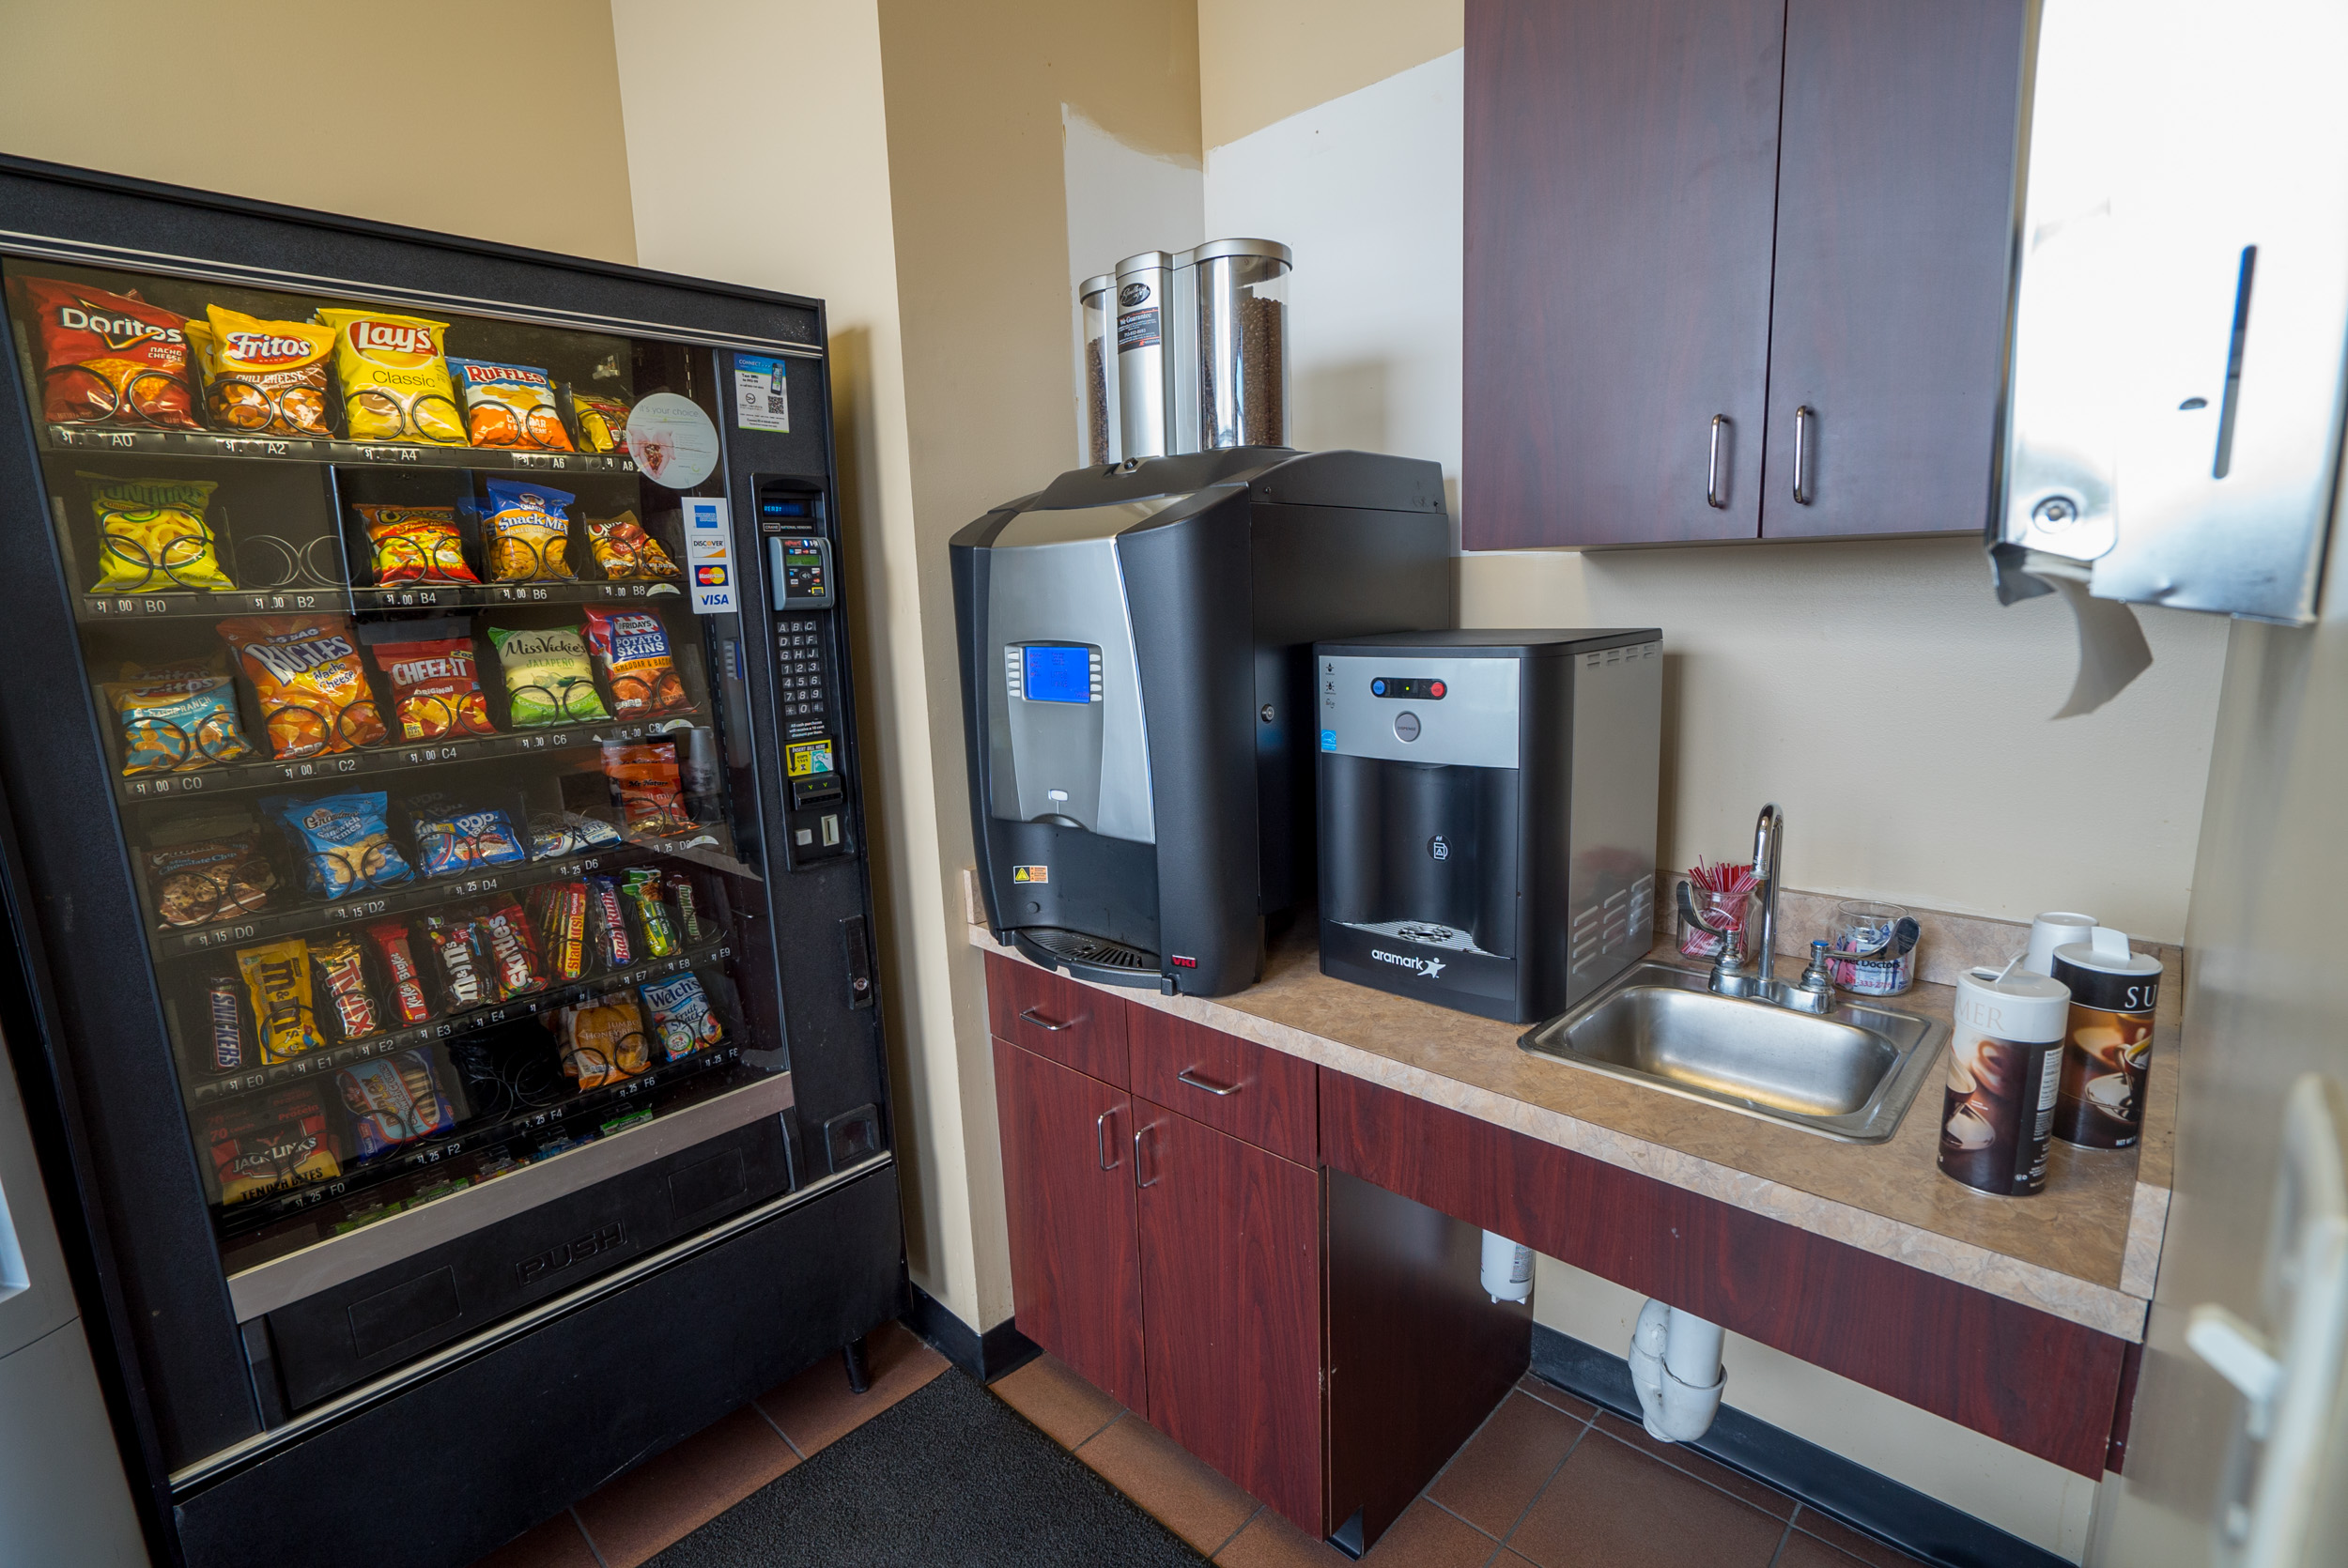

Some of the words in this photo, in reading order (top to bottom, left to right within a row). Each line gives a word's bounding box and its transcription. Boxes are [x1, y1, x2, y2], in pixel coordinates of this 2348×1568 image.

[62, 307, 183, 343] Doritos
[358, 322, 432, 353] Lay's
[150, 346, 182, 356] NACHO
[226, 331, 311, 360] Fritos
[147, 352, 182, 362] CHEESE
[236, 374, 261, 384] CHILI
[372, 370, 436, 387] Classic
[465, 365, 547, 384] RUFFLES
[652, 407, 670, 415] your
[112, 434, 133, 447] A0
[268, 443, 286, 454] A2
[401, 450, 417, 461] A4
[552, 457, 565, 469] A6
[622, 460, 634, 471] A8
[498, 514, 545, 531] Snack
[533, 590, 548, 600] B6
[632, 586, 645, 595] B8
[297, 596, 315, 608] B2
[420, 592, 436, 604] B4
[699, 593, 730, 606] VISA
[622, 620, 652, 630] FRIDAYS
[779, 623, 786, 633] A
[793, 623, 800, 632] B
[806, 622, 813, 631] C
[615, 634, 662, 648] POTATO
[780, 638, 788, 646] D
[794, 637, 801, 645] E
[807, 636, 814, 644] F
[616, 641, 665, 656] SKINS
[781, 652, 789, 660] G
[795, 650, 803, 659] H
[809, 649, 815, 658] J
[244, 636, 353, 687] BUGLES
[614, 659, 645, 671] CHEDDAR
[313, 662, 346, 681] Nacho
[783, 665, 789, 674] 1
[796, 664, 804, 673] 2
[810, 662, 817, 671] 3
[319, 670, 356, 691] Cheese
[784, 679, 791, 687] 4
[797, 677, 805, 686] 5
[811, 676, 818, 685] 6
[786, 693, 793, 701] 7
[799, 691, 806, 699] 8
[812, 689, 819, 699] 9
[179, 696, 212, 713] RANCH
[552, 734, 567, 746] C6
[441, 747, 457, 759] C4
[338, 760, 356, 772] C2
[332, 822, 362, 841] remes
[158, 857, 210, 875] Chocolate
[211, 853, 238, 862] Chip
[584, 858, 599, 869] D6
[482, 879, 498, 891] D4
[368, 900, 386, 914] D2
[610, 924, 631, 960] Baby
[488, 915, 530, 987] Skittles
[719, 947, 731, 958] E9
[679, 959, 690, 969] E8
[1172, 956, 1196, 968] VKI
[1371, 949, 1424, 971] aramark
[1861, 960, 1901, 969] Doctors
[443, 940, 478, 1003] m&m's
[636, 971, 647, 981] E7
[260, 960, 302, 1038] m&m's
[325, 957, 376, 1037] TWIX
[648, 980, 701, 1007] Welch's
[491, 1010, 505, 1022] E4
[674, 1003, 698, 1020] Fruit
[212, 993, 240, 1068] SNICKERS
[608, 1020, 639, 1029] JUMBO
[437, 1024, 451, 1038] E3
[585, 1029, 619, 1040] HONEY
[378, 1039, 394, 1053] E2
[317, 1056, 332, 1069] E1
[643, 1077, 656, 1087] F6
[278, 1104, 319, 1121] Protein
[550, 1108, 563, 1120] F4
[447, 1144, 461, 1156] F2
[233, 1150, 270, 1173] JACK
[516, 1222, 625, 1285] PUSH
